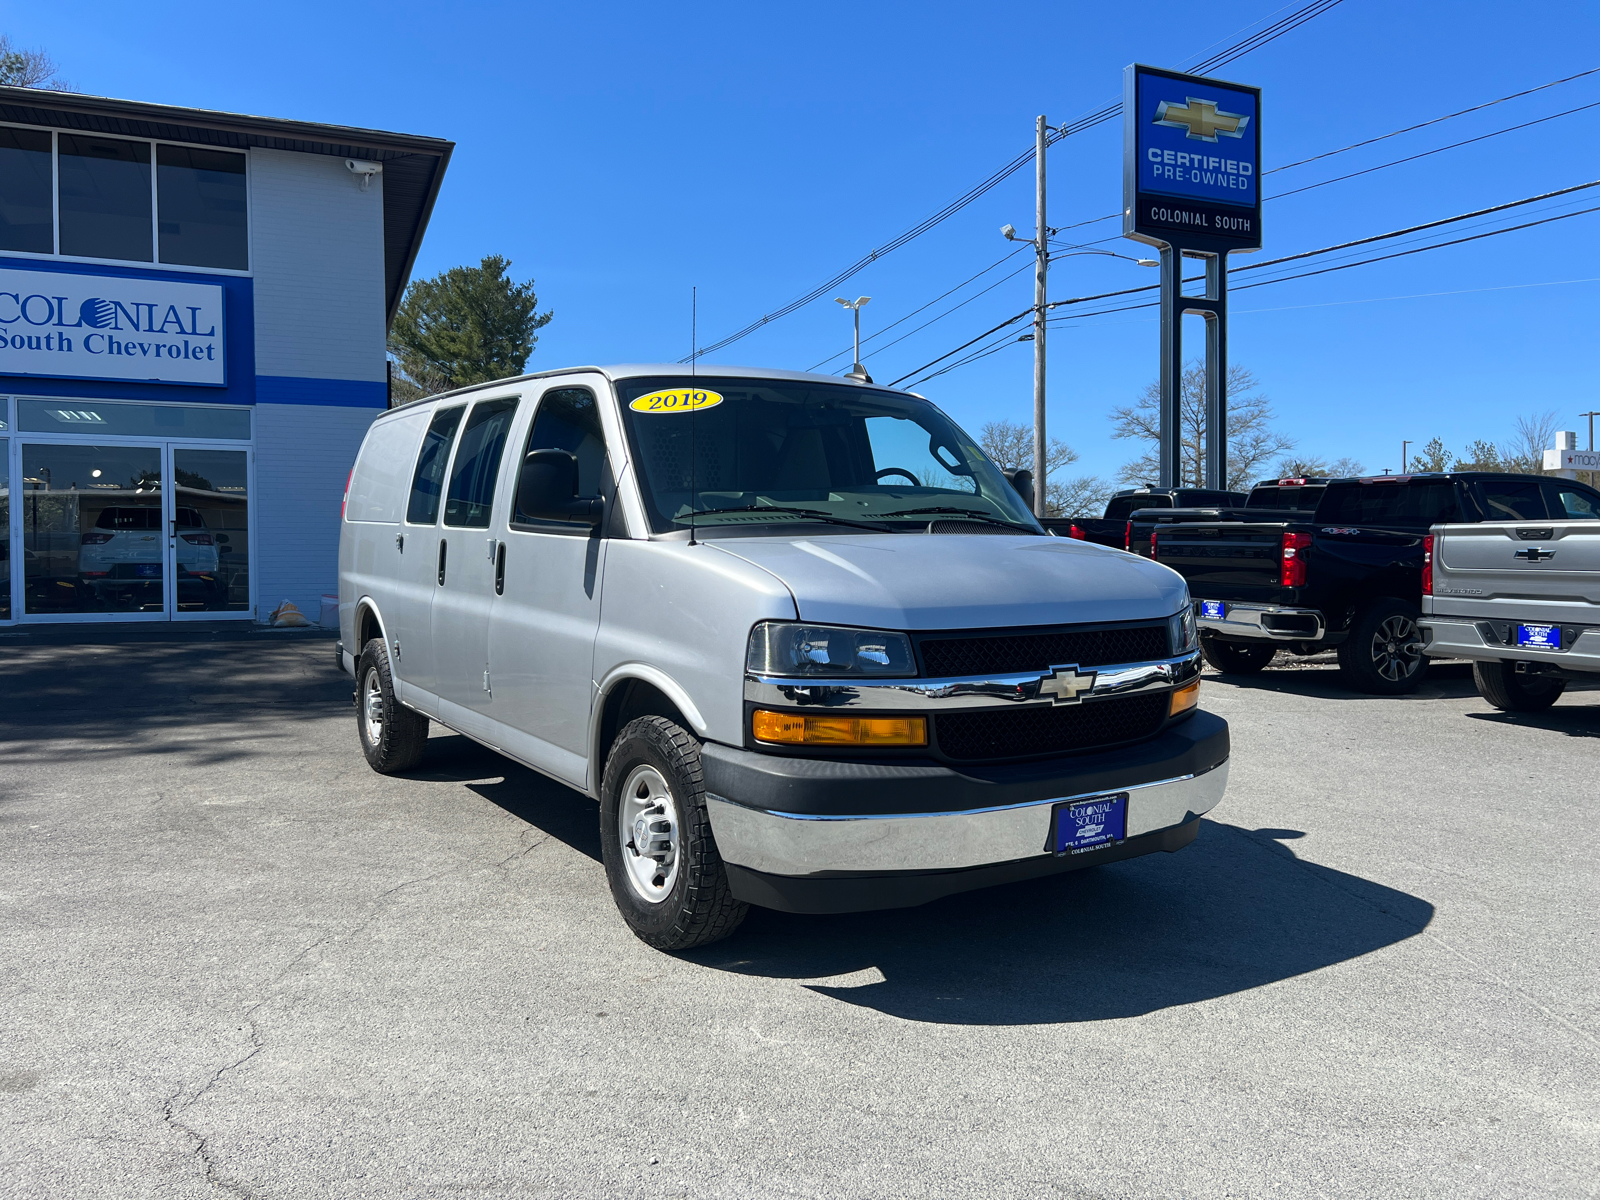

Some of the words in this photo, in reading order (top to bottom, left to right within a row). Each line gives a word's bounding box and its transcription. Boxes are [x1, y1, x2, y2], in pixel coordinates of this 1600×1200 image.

[1147, 147, 1252, 176] CERTIFIED
[1153, 164, 1248, 190] PRE-OWNED
[1151, 206, 1208, 227] COLONIAL
[1215, 214, 1251, 232] SOUTH
[0, 292, 215, 336] COLONIAL
[83, 333, 216, 361] Chevrolet
[648, 392, 708, 410] 2019
[1070, 803, 1112, 819] COLONIAL
[1076, 813, 1105, 827] SOUTH
[1071, 847, 1094, 855] COLONIAL
